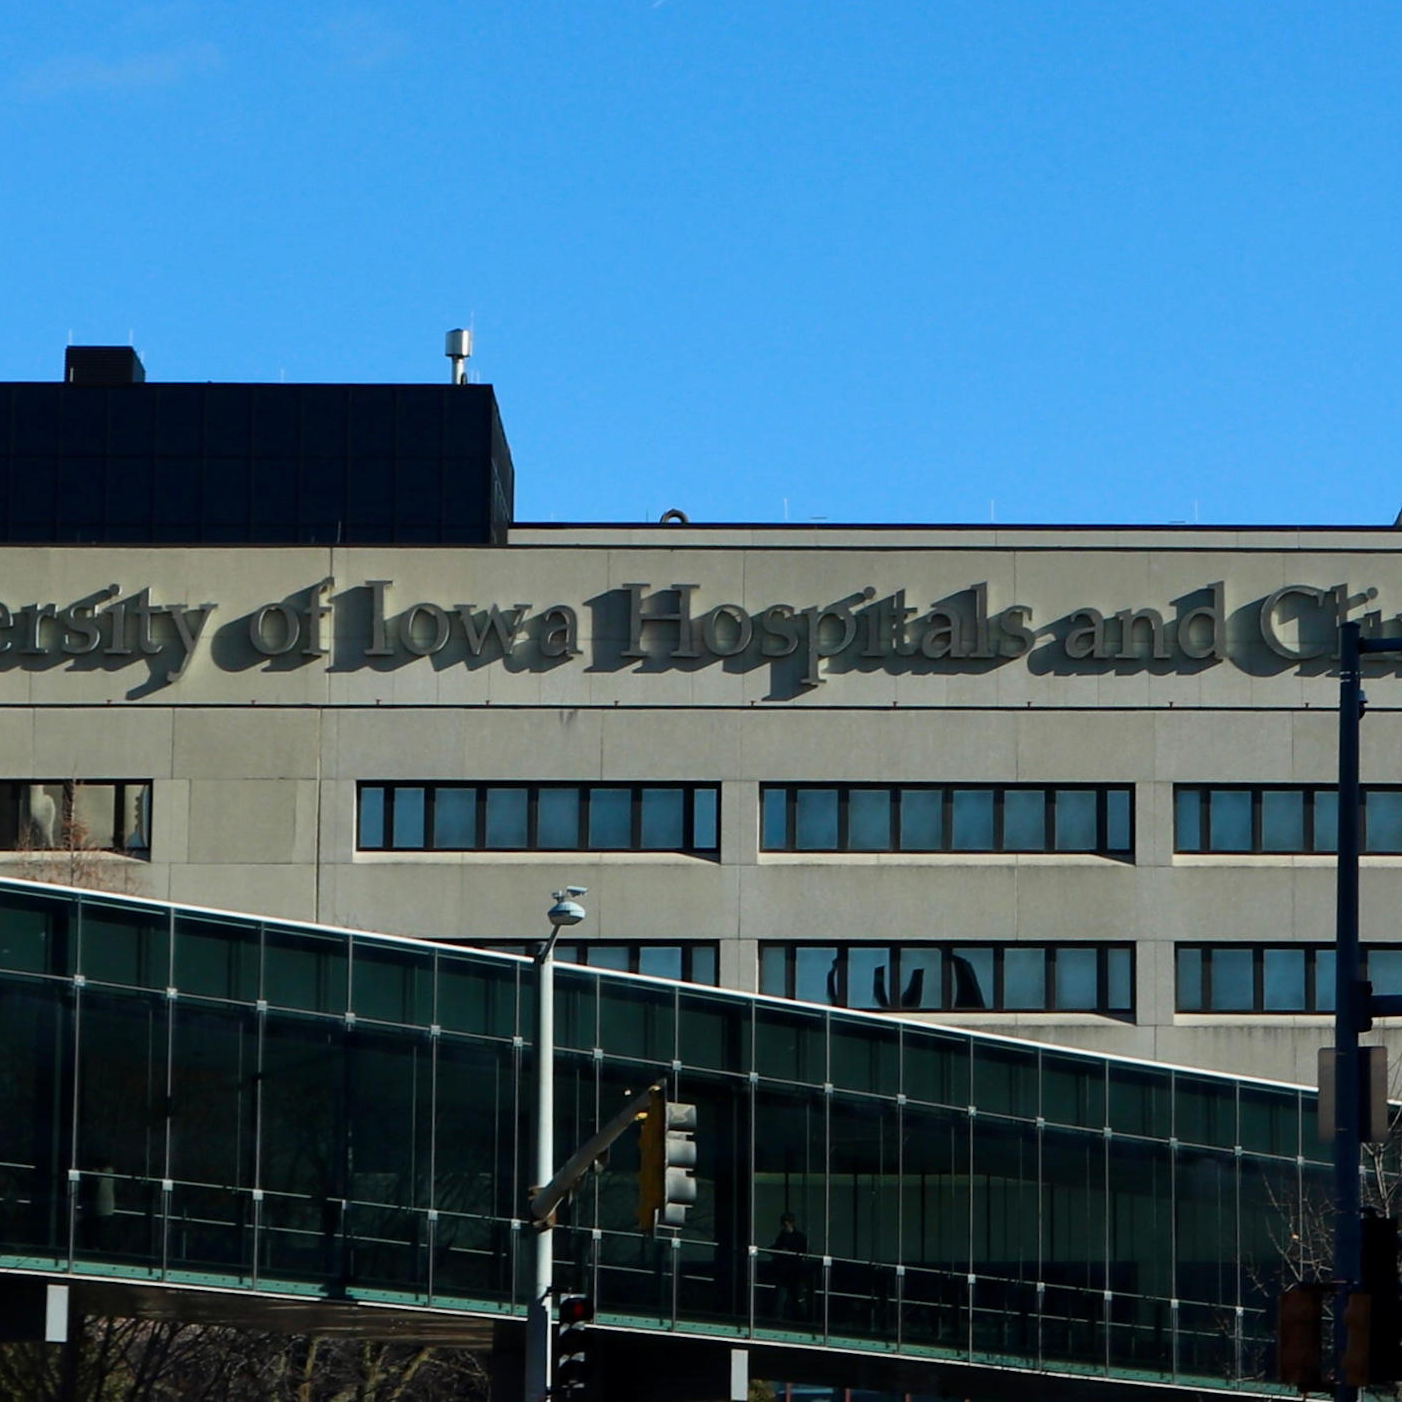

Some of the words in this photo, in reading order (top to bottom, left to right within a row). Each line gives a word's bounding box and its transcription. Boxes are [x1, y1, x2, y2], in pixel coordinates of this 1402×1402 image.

[251, 576, 335, 656] of
[364, 579, 582, 657] Iowa
[620, 582, 1034, 684] Hospitals
[1063, 580, 1228, 662] and
